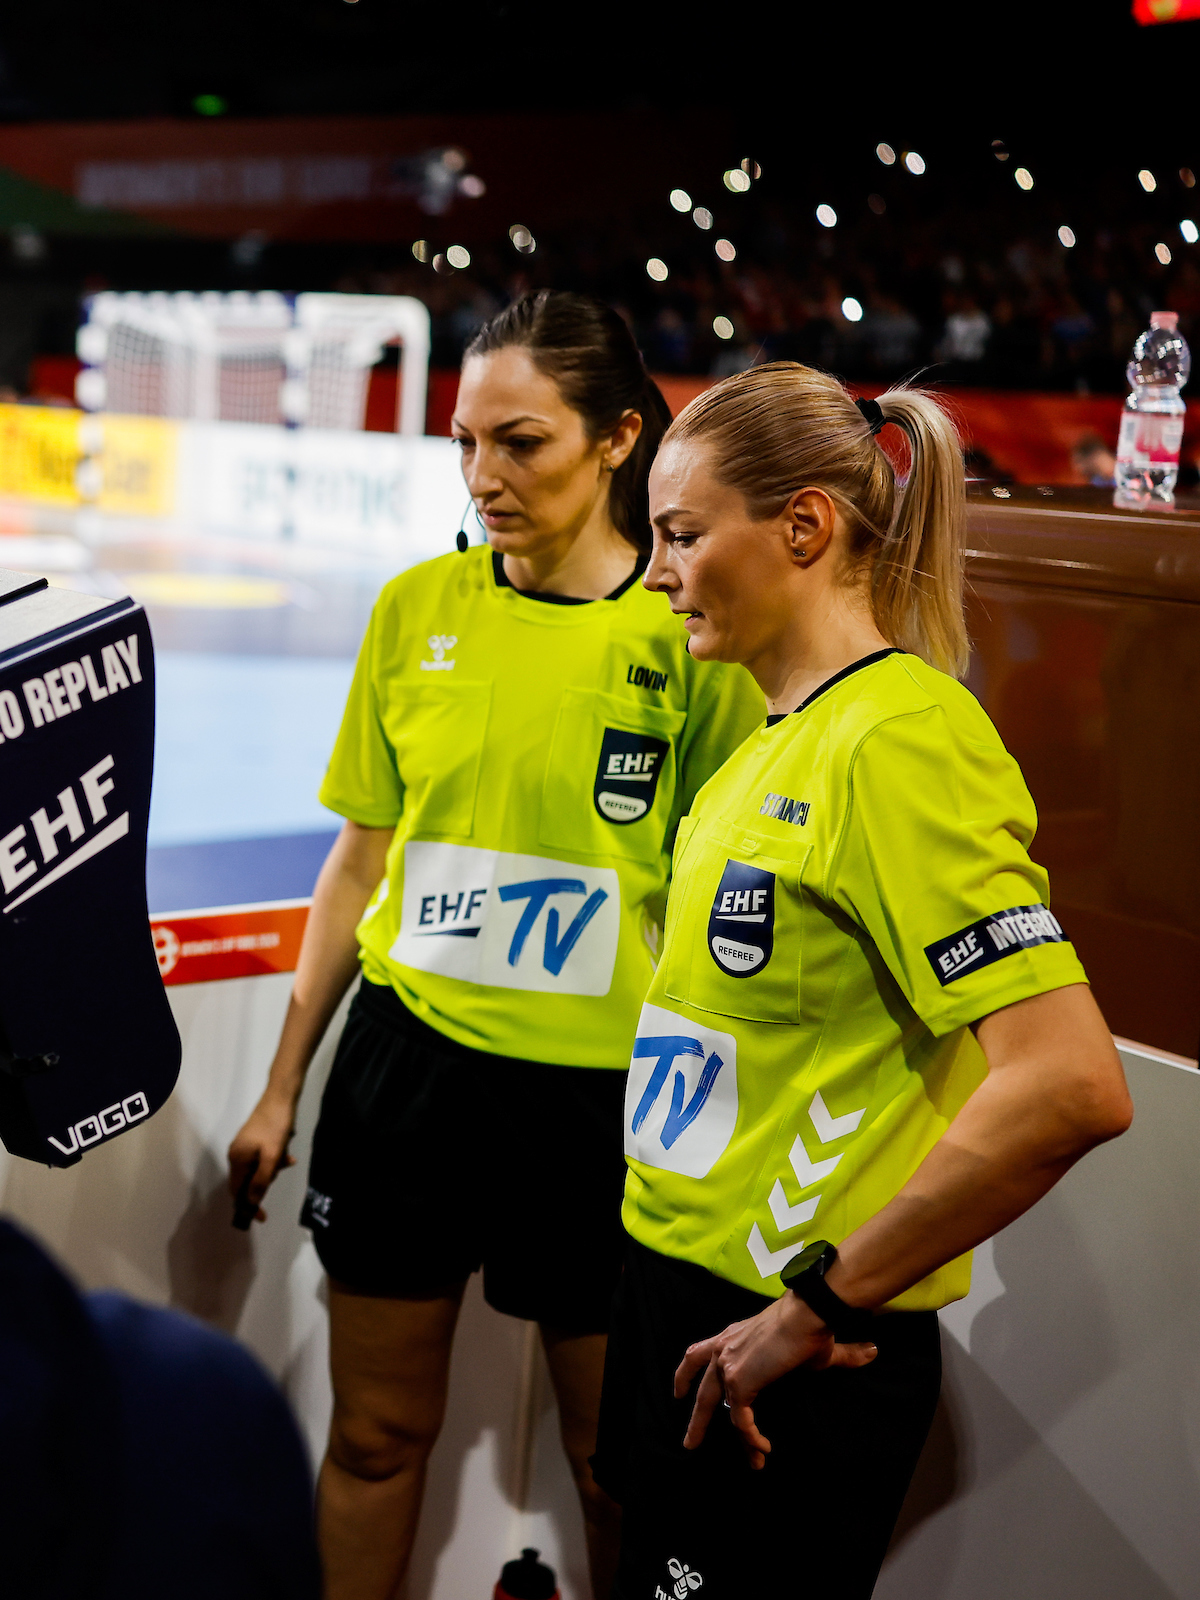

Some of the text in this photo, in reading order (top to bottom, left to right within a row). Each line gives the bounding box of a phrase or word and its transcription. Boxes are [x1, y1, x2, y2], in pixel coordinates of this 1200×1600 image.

[23, 635, 143, 728] REPLAY
[627, 664, 668, 692] LOVIN
[606, 752, 658, 774] EHF
[605, 800, 638, 813] REFEREE
[760, 792, 811, 827] STANCU
[718, 889, 768, 913] EHF
[418, 878, 608, 977] EHF TV
[937, 909, 1063, 973] EHF INTEGRIT
[718, 944, 755, 962] REFEREE
[632, 1035, 724, 1151] TV
[47, 1091, 150, 1155] VOGO
